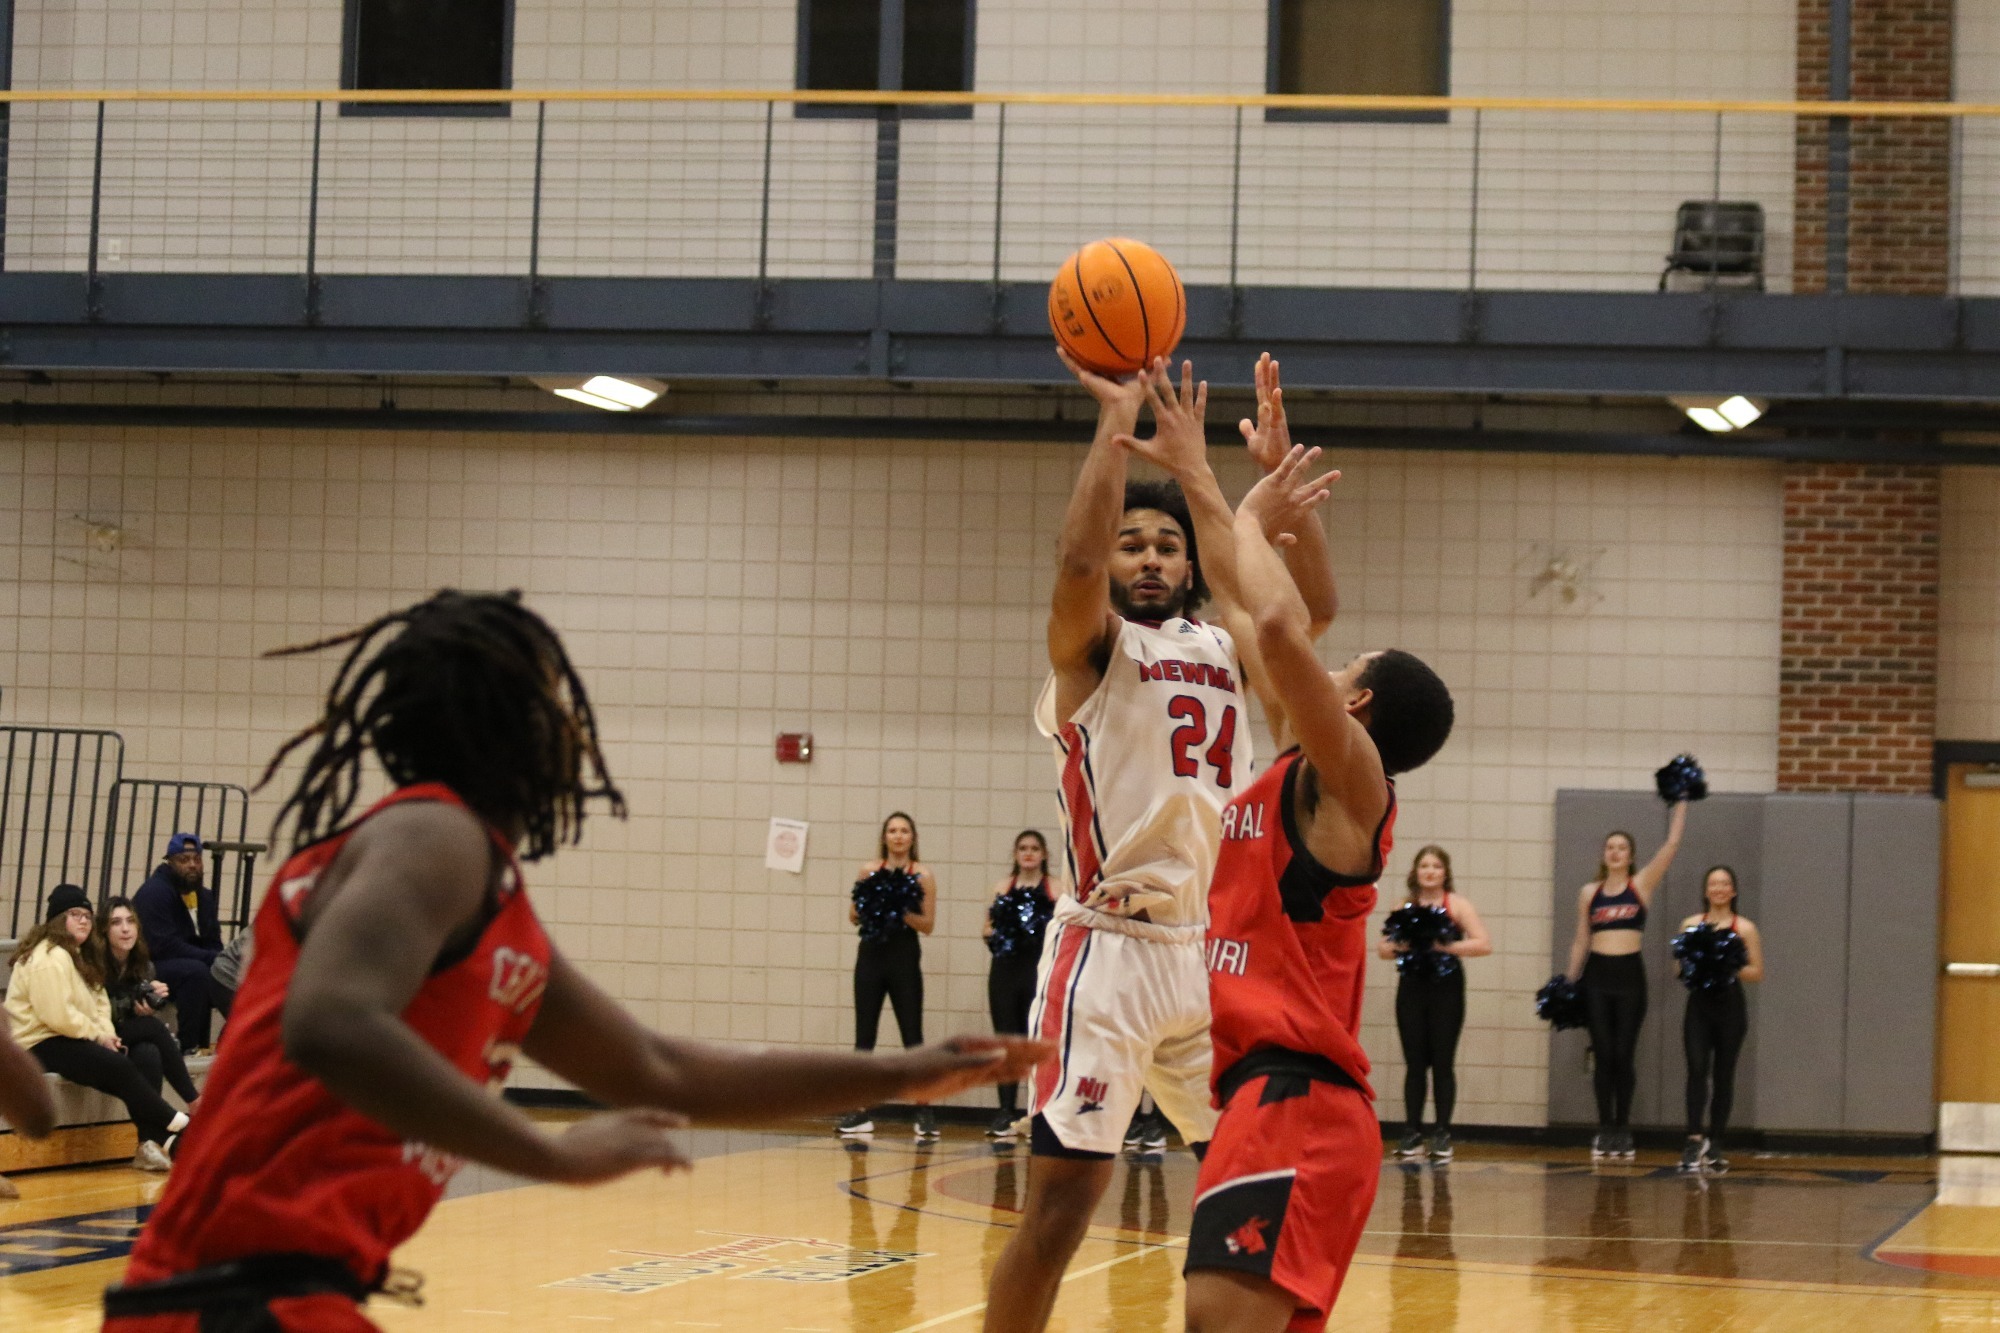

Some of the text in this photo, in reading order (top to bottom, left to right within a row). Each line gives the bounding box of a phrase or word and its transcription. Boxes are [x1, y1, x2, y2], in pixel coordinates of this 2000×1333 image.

[1168, 694, 1236, 789] 24
[1075, 1076, 1109, 1102] NU
[545, 1260, 740, 1292] COURT
